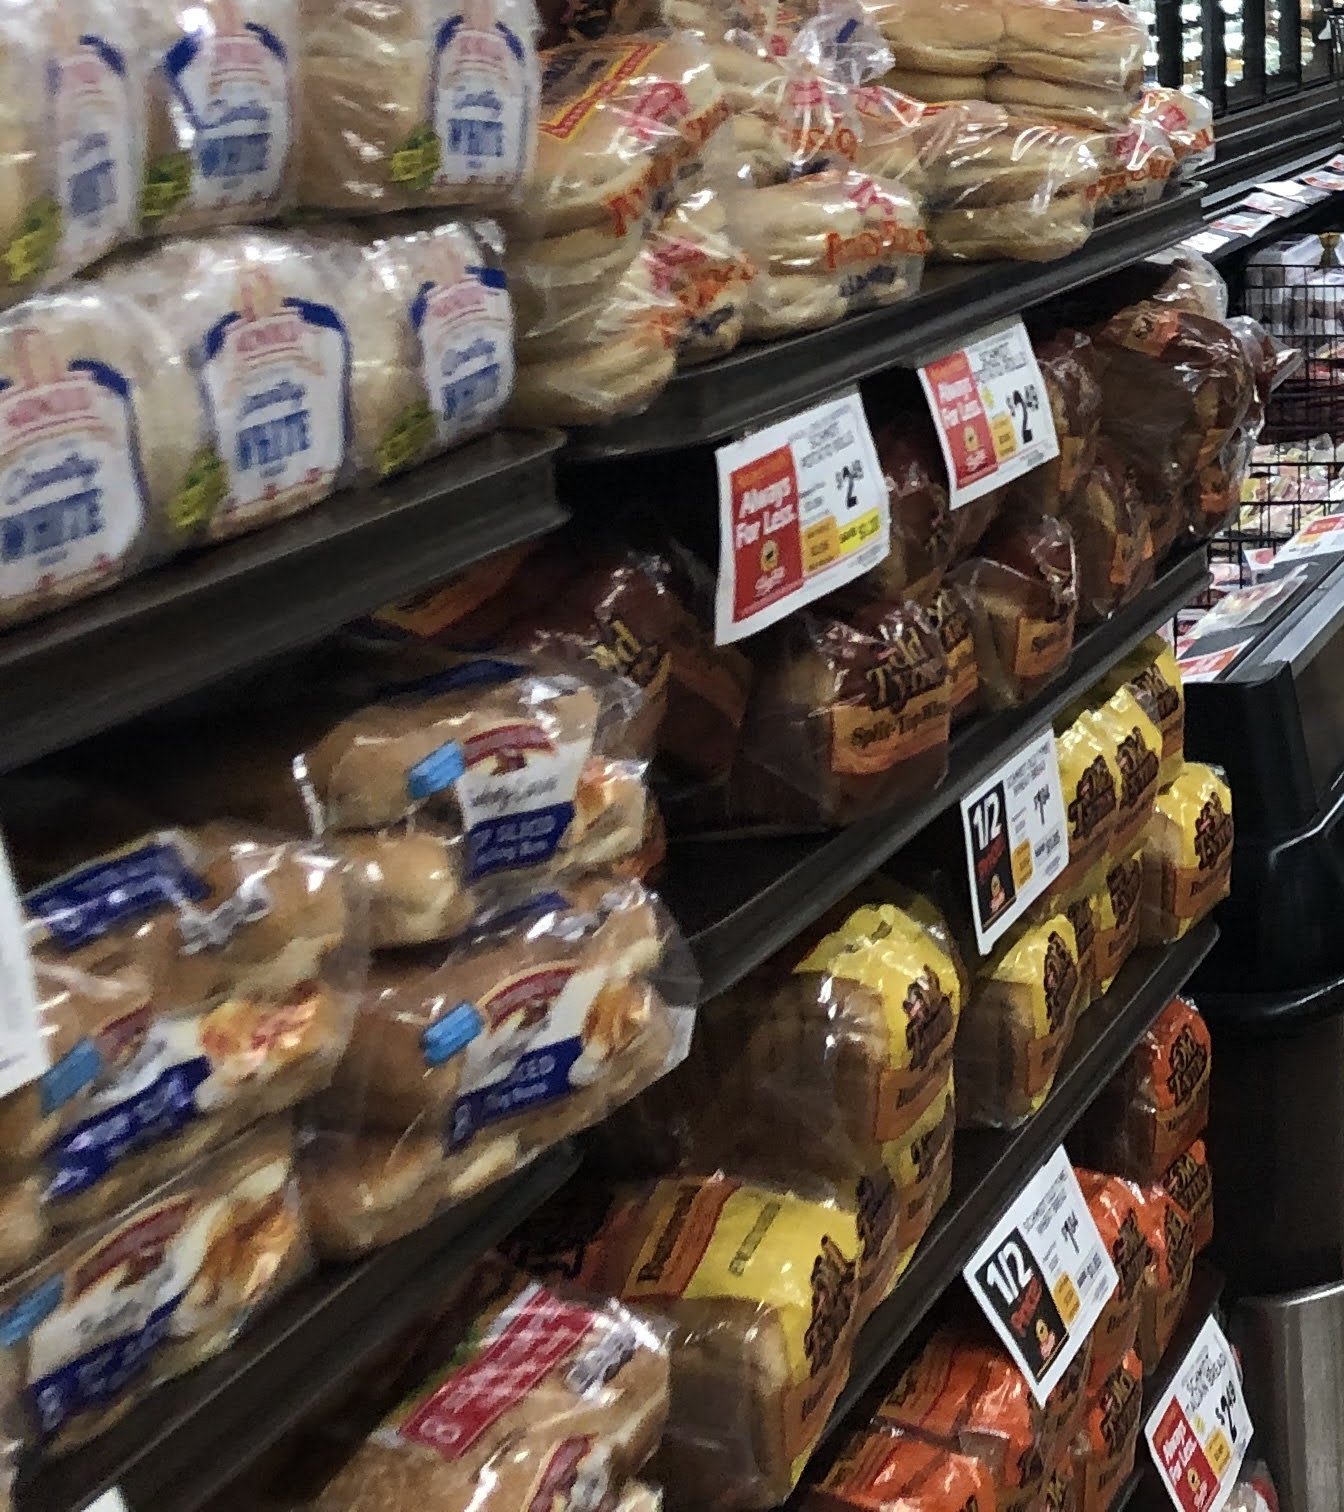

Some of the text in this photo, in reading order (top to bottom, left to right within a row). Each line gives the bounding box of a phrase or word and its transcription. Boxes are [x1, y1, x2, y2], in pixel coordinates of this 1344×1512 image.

[738, 476, 792, 519] Always
[735, 505, 797, 550] For Less.
[973, 791, 1003, 851] 1/2
[987, 1240, 1032, 1306] 1/2
